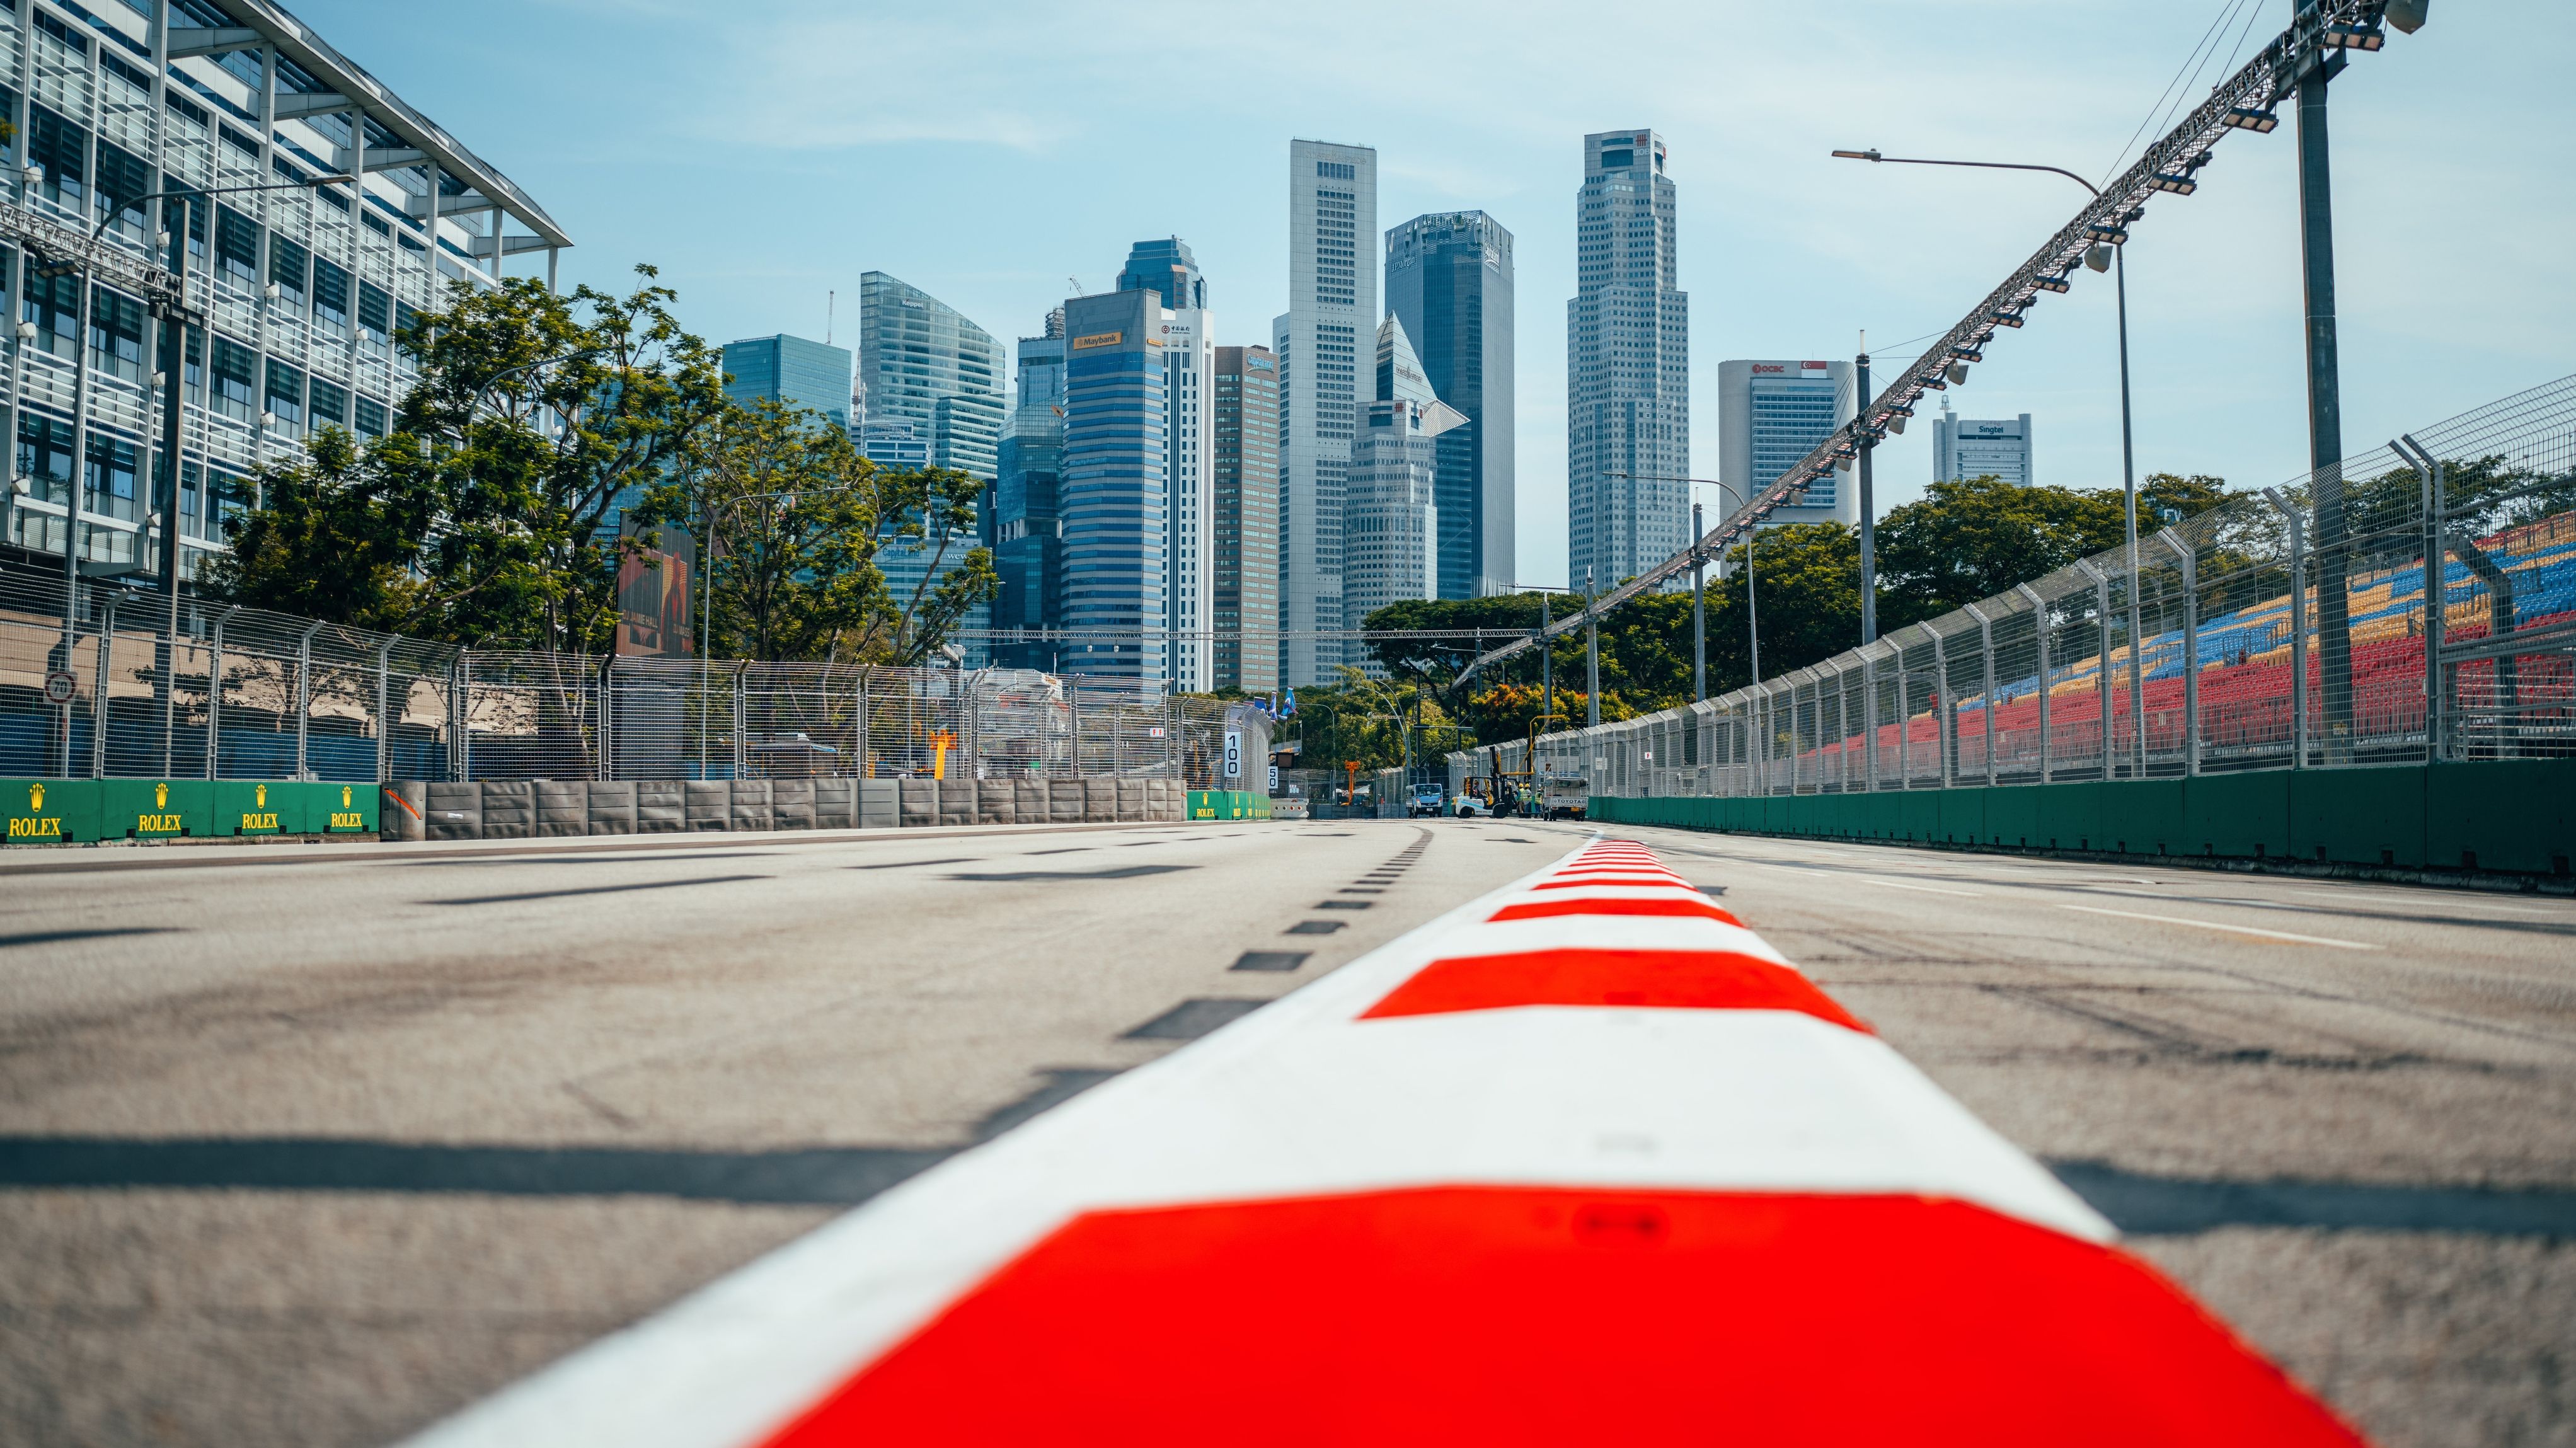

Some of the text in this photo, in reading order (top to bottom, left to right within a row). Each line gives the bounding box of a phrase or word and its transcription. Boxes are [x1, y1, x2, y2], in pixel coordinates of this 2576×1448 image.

[902, 299, 923, 307] Keppel
[1084, 334, 1116, 345] Maybank
[1979, 425, 2003, 434] Singtel
[646, 616, 658, 628] HALL
[55, 681, 67, 693] 70
[1229, 735, 1237, 774] 100
[1270, 769, 1275, 786] 50
[1197, 808, 1214, 817] ROLEX
[138, 815, 181, 831] ROLEX
[242, 813, 278, 829] ROLEX
[331, 813, 362, 827] ROLEX
[9, 818, 61, 837] ROLEX
